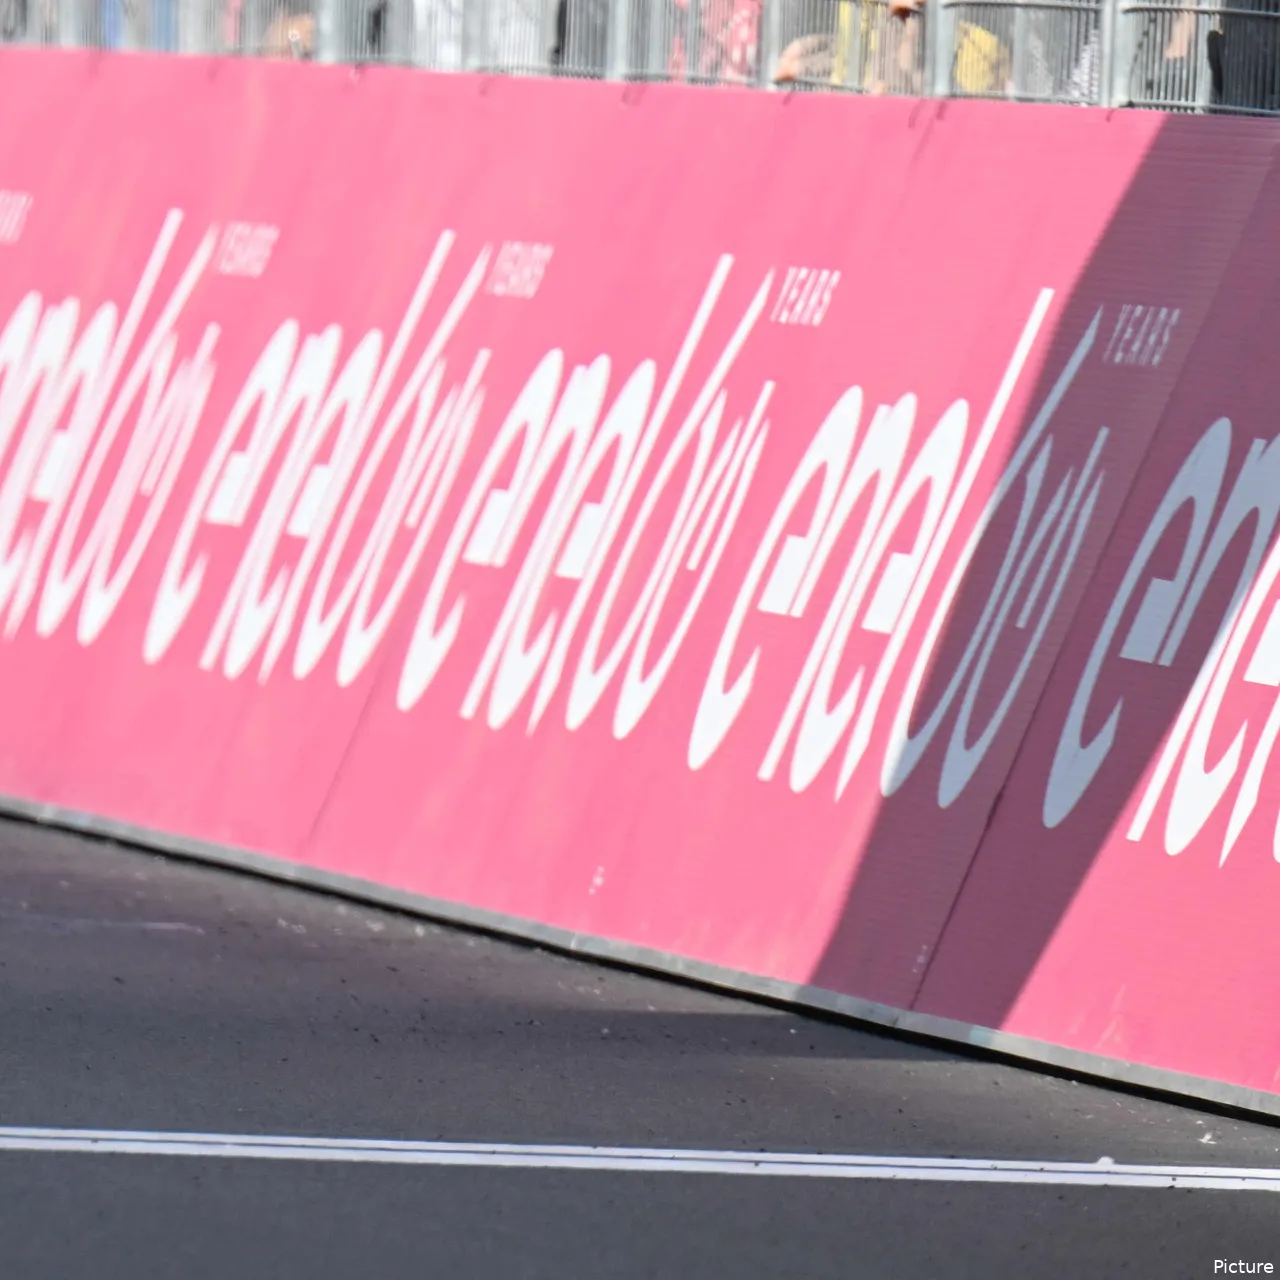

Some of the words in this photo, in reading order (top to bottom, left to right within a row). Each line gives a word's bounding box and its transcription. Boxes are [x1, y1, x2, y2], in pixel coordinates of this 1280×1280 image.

[771, 266, 841, 325] YEARS
[1104, 304, 1181, 366] YEARS
[396, 252, 734, 739] enel
[688, 286, 1054, 804] enel
